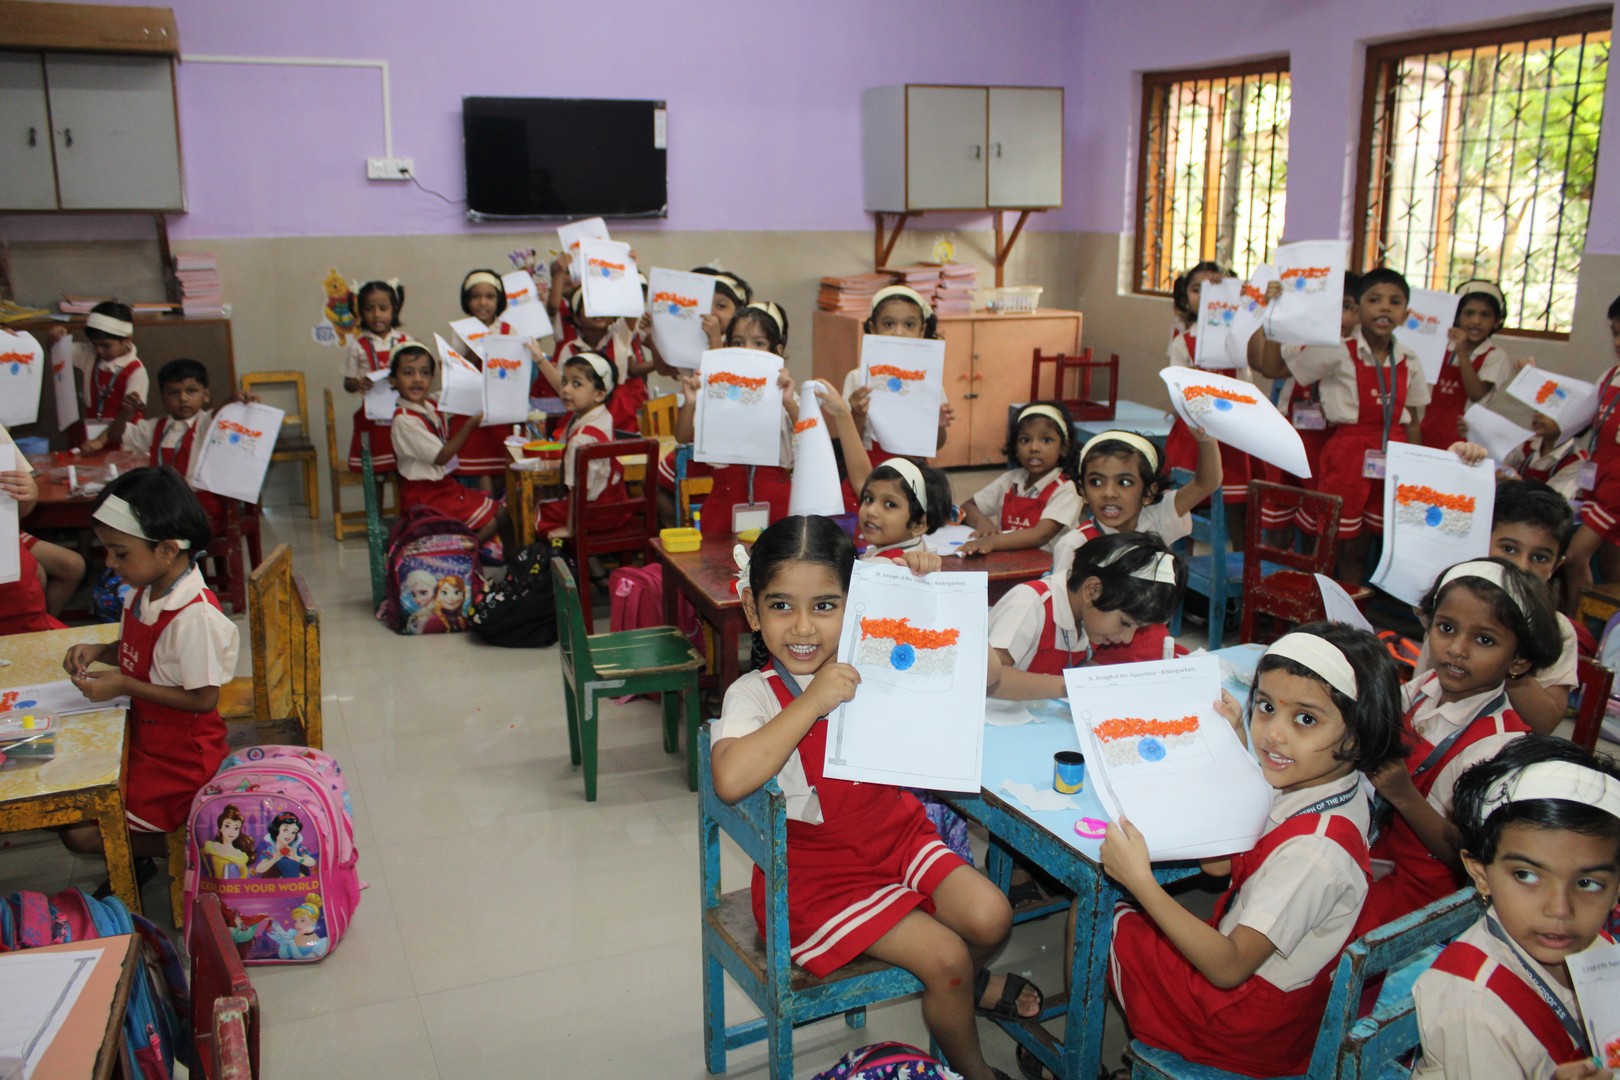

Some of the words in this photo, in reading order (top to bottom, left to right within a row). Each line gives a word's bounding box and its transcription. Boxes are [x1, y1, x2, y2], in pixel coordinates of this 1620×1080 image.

[1095, 673, 1114, 681] Joseph
[1316, 802, 1325, 810] OF
[1325, 797, 1339, 806] THE
[243, 884, 276, 893] YOUR
[278, 880, 319, 892] WORLD
